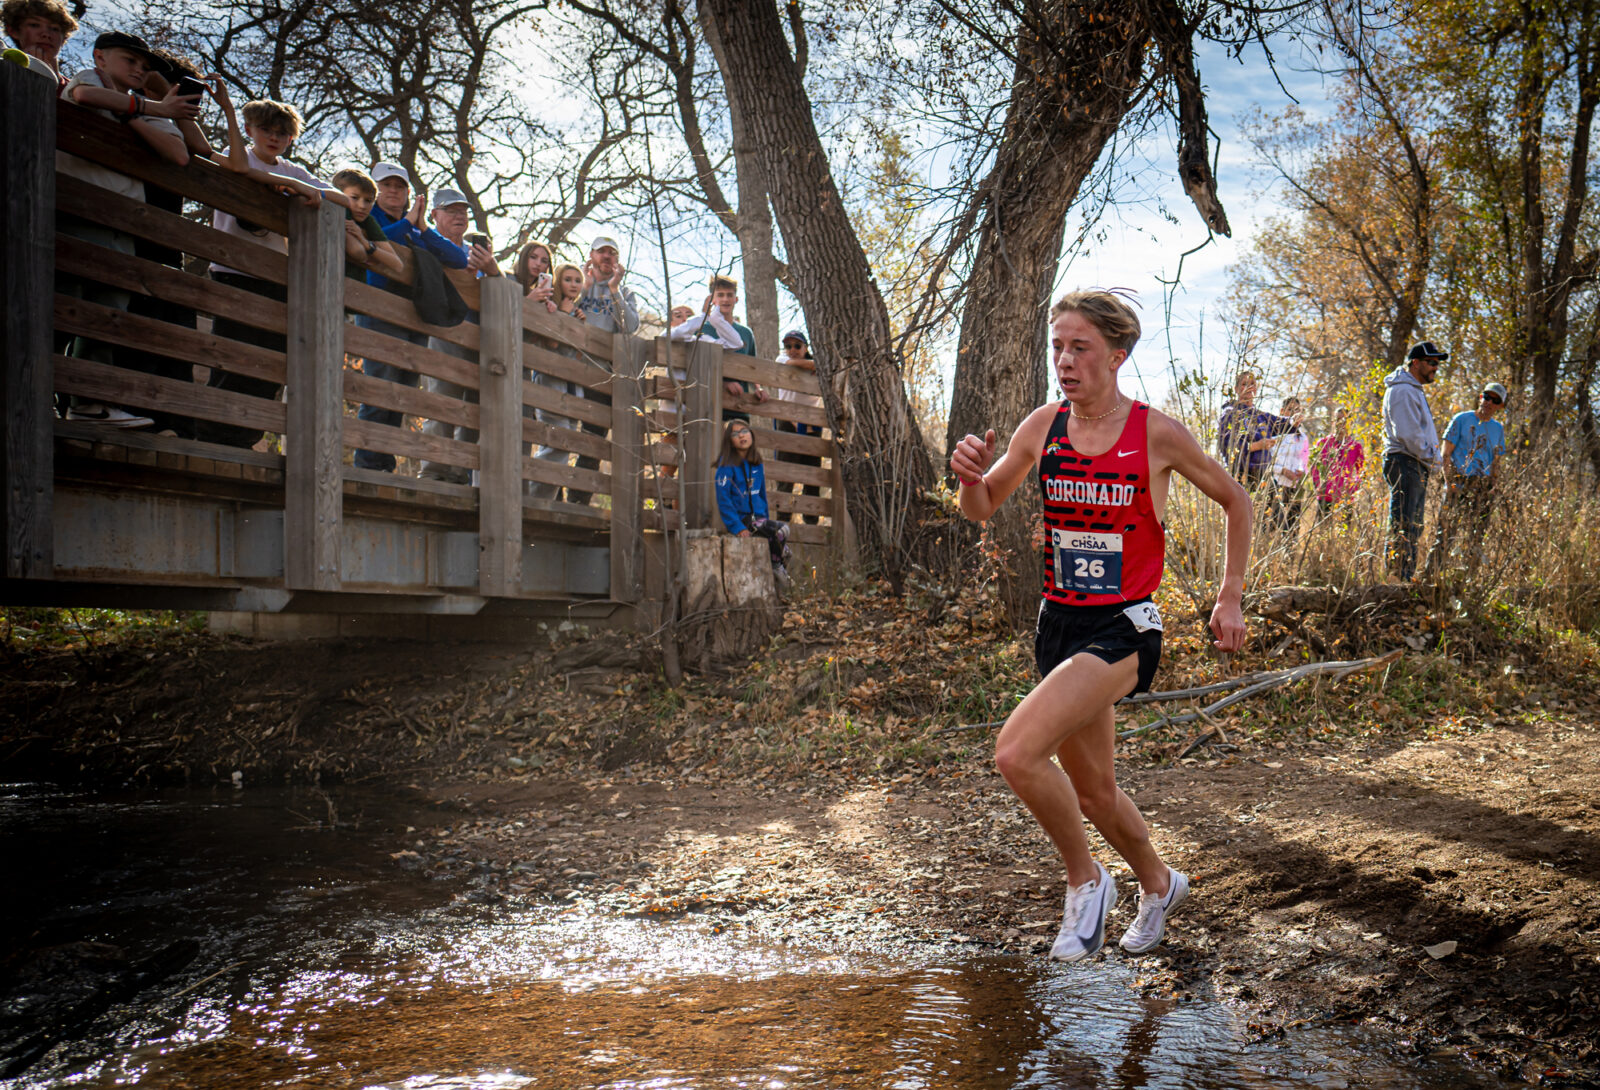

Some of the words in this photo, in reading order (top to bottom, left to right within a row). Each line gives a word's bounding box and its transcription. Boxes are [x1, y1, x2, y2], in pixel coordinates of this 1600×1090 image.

[1046, 478, 1135, 507] CORONADO
[1071, 539, 1108, 550] CHSAA
[1074, 557, 1106, 578] 26
